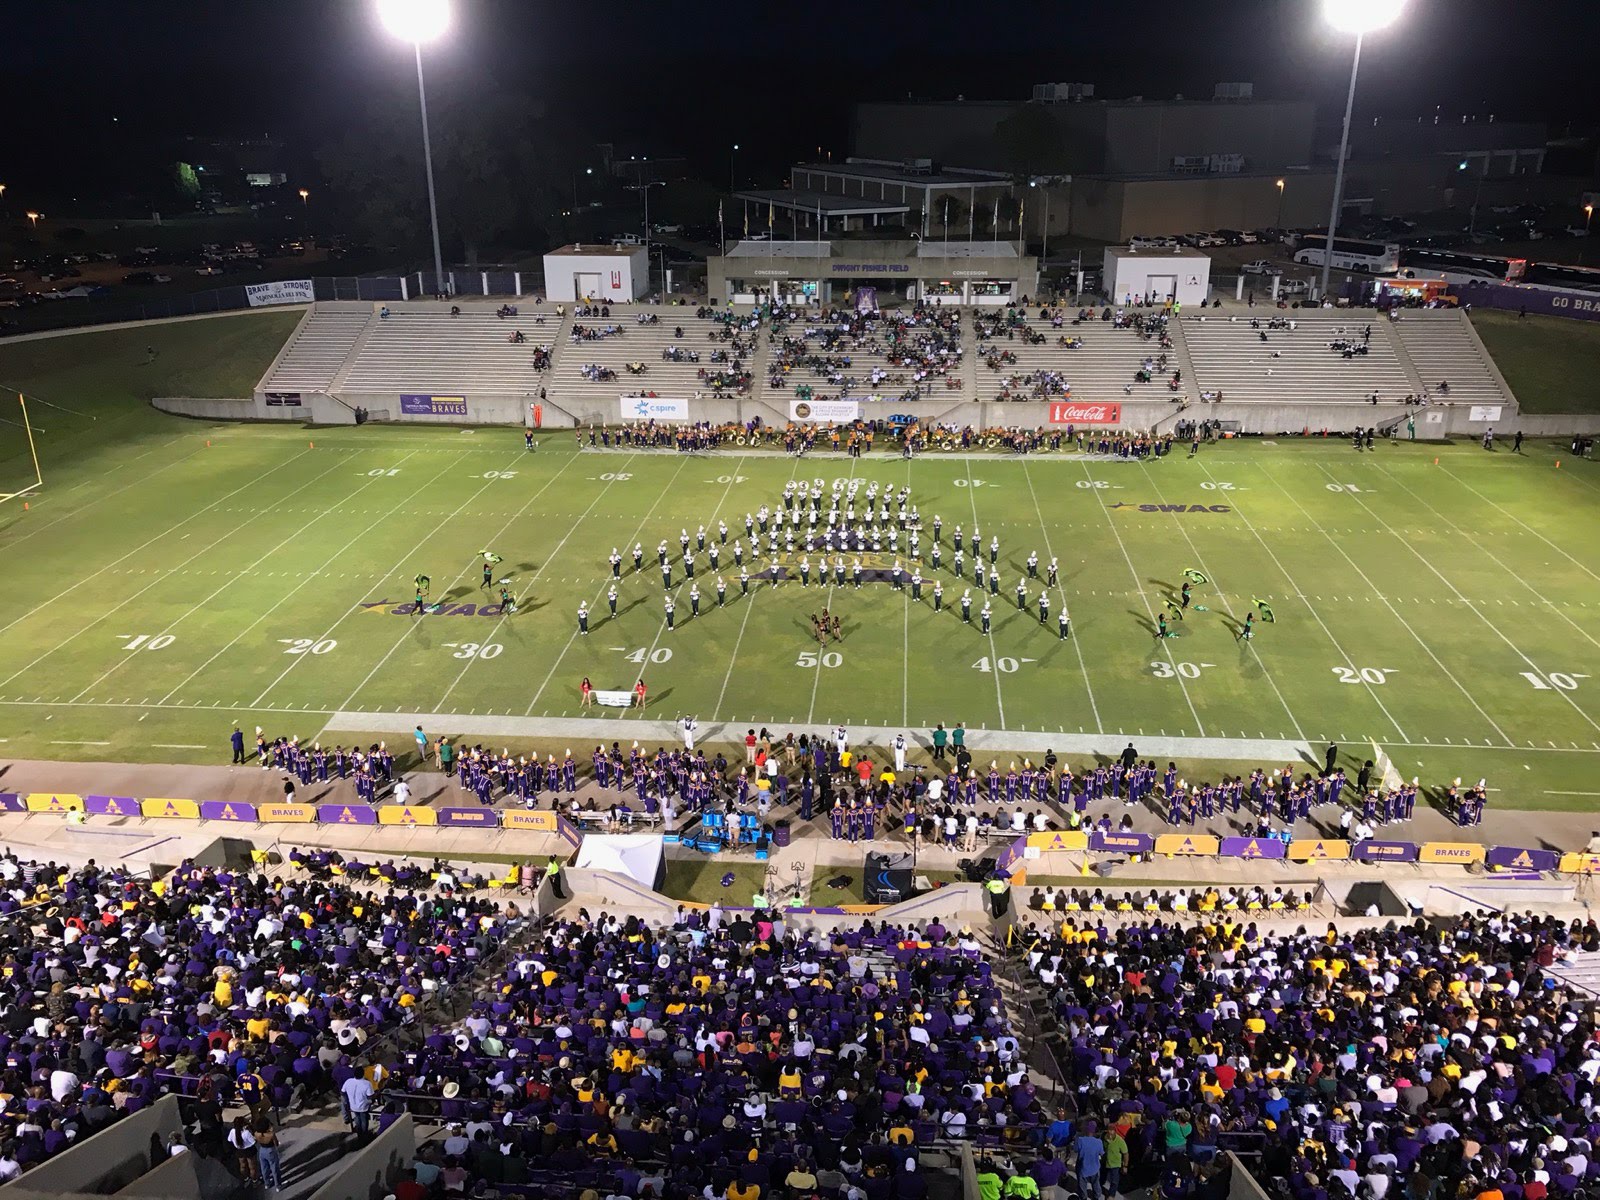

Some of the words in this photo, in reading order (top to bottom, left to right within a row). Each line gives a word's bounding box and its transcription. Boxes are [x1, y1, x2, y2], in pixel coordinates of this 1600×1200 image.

[832, 264, 861, 272] DWIGHT
[862, 264, 888, 272] FISHER
[889, 264, 909, 272] FIELD
[247, 284, 271, 296] BRAVE
[1552, 297, 1569, 307] GO
[431, 404, 466, 414] BRAVES
[655, 405, 676, 413] spire
[1138, 504, 1231, 514] SWAC
[120, 634, 176, 650] 10
[283, 639, 338, 655] 20
[453, 642, 504, 659] 30
[624, 647, 673, 664] 40
[796, 651, 843, 668] 50
[972, 656, 1019, 673] 40
[1150, 661, 1201, 678] 30
[1331, 666, 1387, 684] 20
[1518, 672, 1580, 690] 10
[513, 815, 545, 824] BRAVES
[1435, 849, 1471, 857] BRAVES
